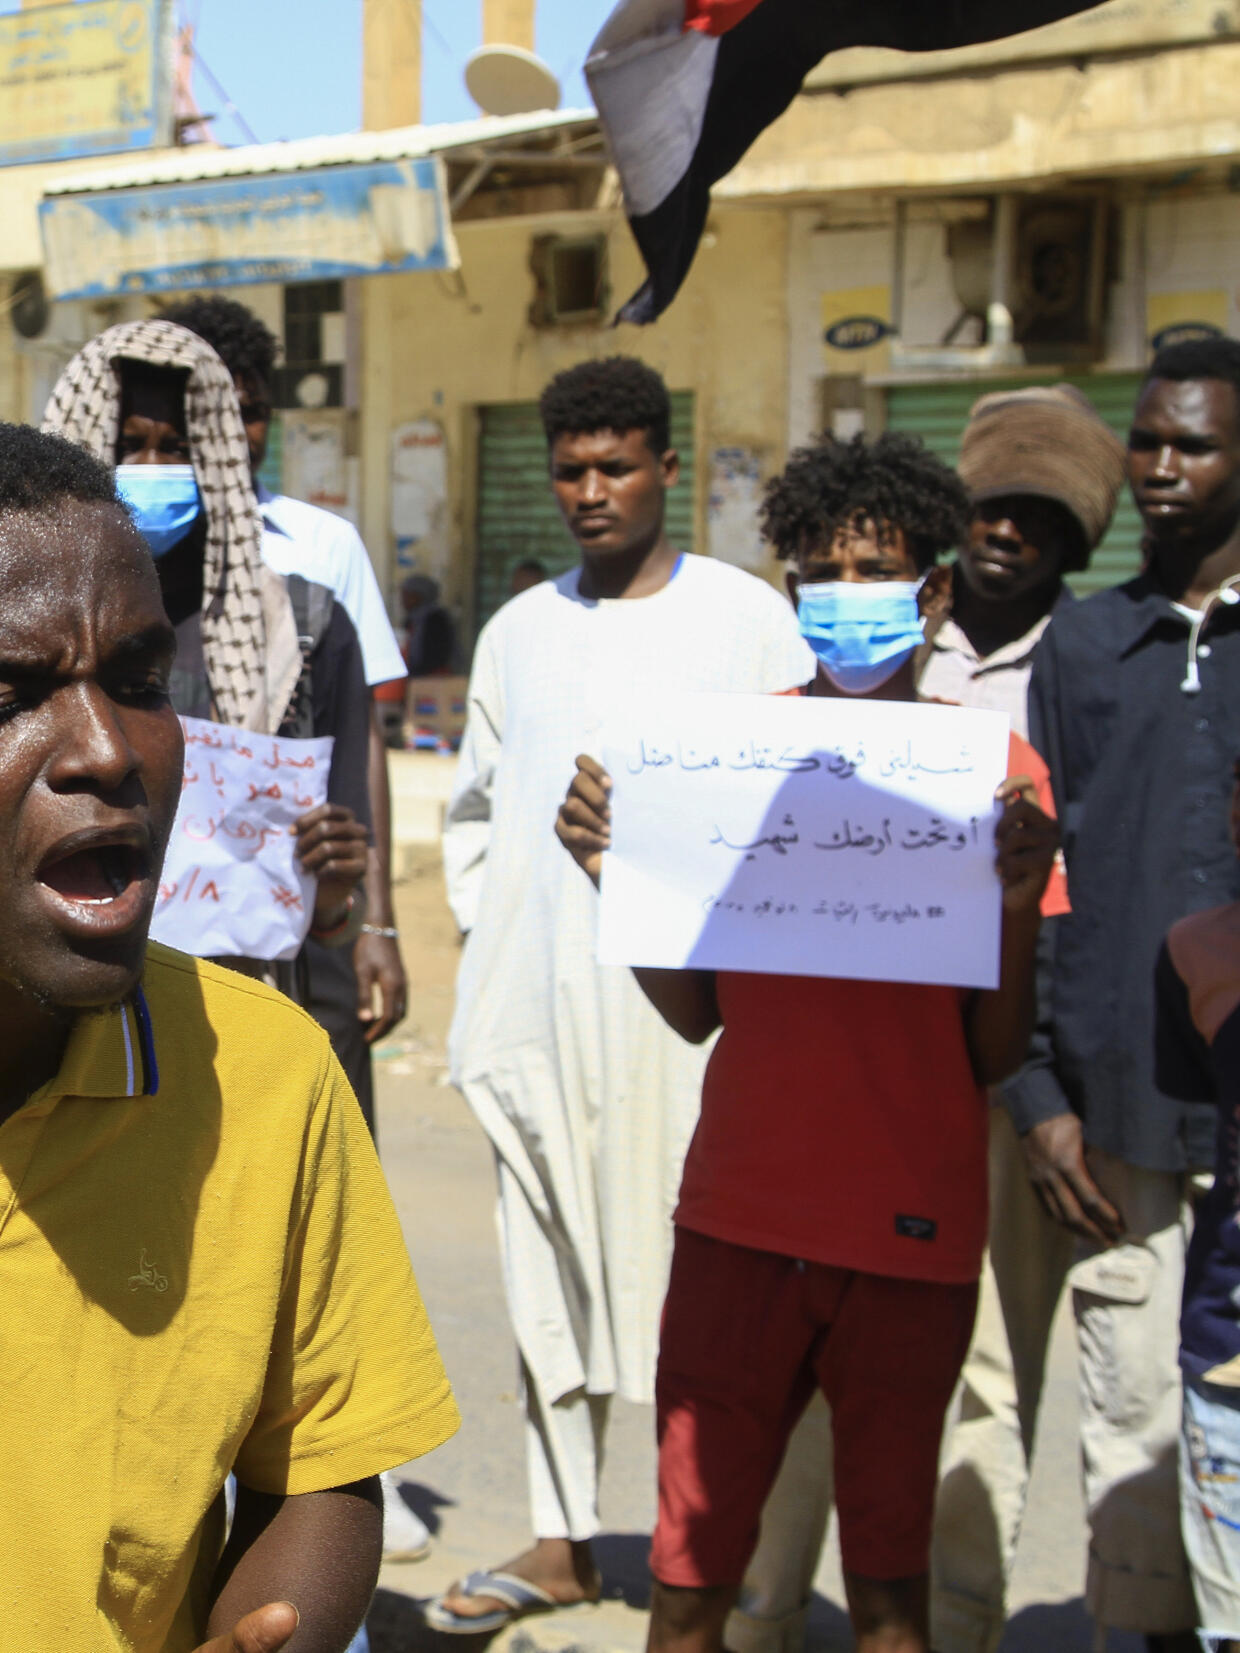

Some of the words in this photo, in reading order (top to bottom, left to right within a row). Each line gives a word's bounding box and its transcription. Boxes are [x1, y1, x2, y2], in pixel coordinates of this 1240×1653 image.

[727, 739, 822, 773] كتفك
[827, 740, 867, 780] فوق
[182, 806, 284, 854] برهان
[709, 813, 799, 862] شهيد
[813, 818, 893, 856] أرضك
